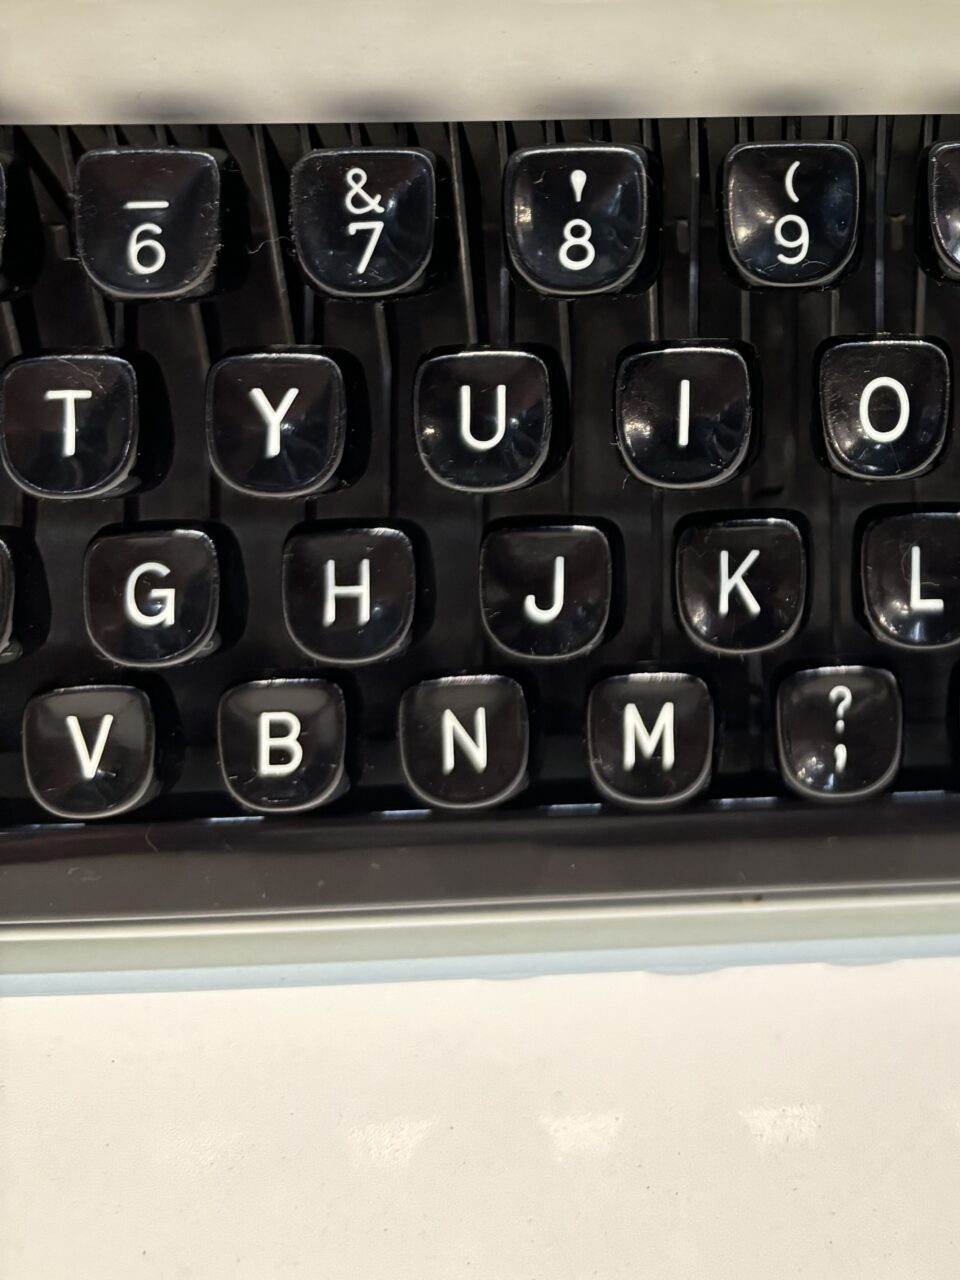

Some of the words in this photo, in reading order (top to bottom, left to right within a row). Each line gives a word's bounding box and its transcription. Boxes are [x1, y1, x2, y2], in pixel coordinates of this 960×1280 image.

[345, 167, 385, 215] &
[785, 161, 800, 203] (
[128, 223, 166, 275] 6
[348, 221, 385, 274] 7
[558, 218, 596, 271] 8
[774, 213, 810, 265] 9
[45, 389, 93, 457] T
[250, 387, 299, 457] Y
[460, 384, 507, 450] U
[678, 379, 690, 446] I
[856, 376, 910, 443] O
[125, 562, 176, 626] G
[324, 558, 371, 625] H
[524, 556, 565, 623] J
[719, 549, 761, 615] K
[910, 546, 944, 612] L
[442, 706, 487, 772] N
[623, 701, 675, 769] M
[829, 685, 853, 734] ?
[66, 714, 114, 779] V
[259, 711, 303, 776] B
